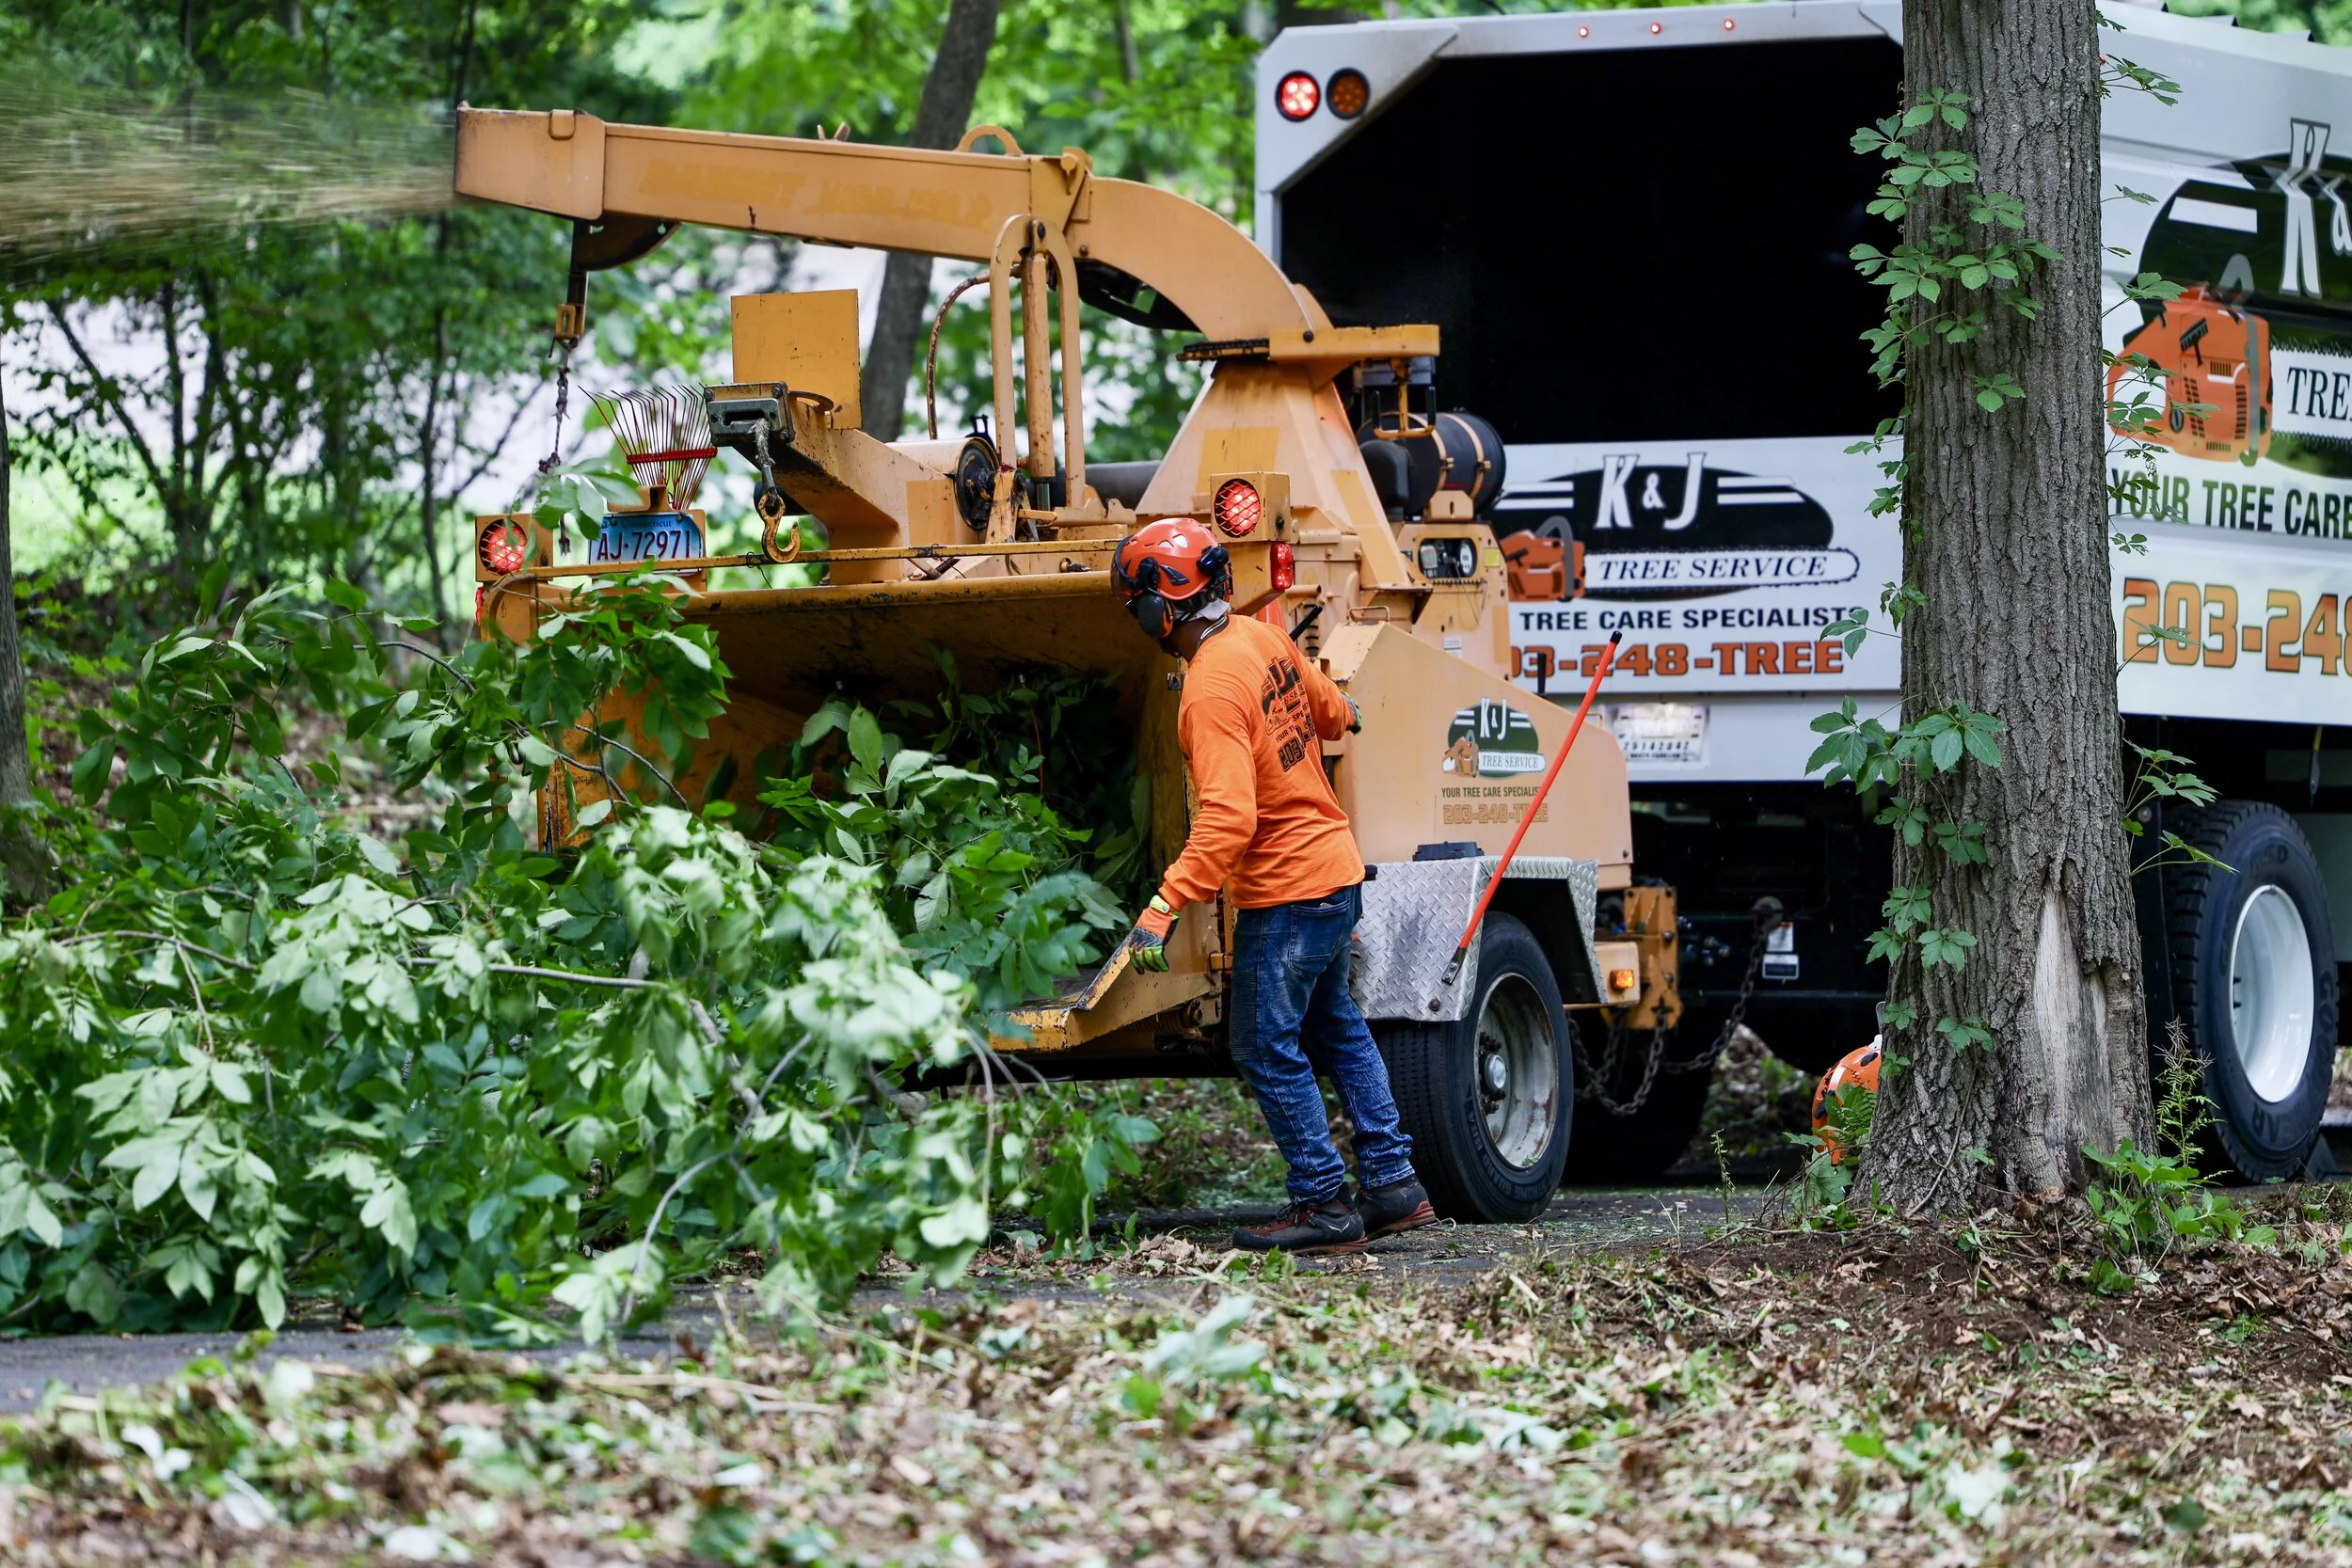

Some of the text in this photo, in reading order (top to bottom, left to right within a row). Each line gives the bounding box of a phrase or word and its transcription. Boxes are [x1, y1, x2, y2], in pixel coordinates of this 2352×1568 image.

[2287, 367, 2352, 421] TRE
[1594, 451, 1707, 531] K & J
[2111, 467, 2189, 523] YOUR
[2202, 480, 2275, 531] TREE
[1599, 555, 1827, 580] TREE SERVICE
[1519, 607, 1864, 631] TREE CARE SPECIALIST
[2123, 578, 2352, 676] 203-24
[1479, 697, 1490, 737] K
[1497, 698, 1507, 740] J
[1482, 755, 1538, 768] TREE SERVICE
[1441, 787, 1461, 798] YOUR
[1463, 787, 1481, 798] TREE
[1482, 787, 1502, 797] CARE
